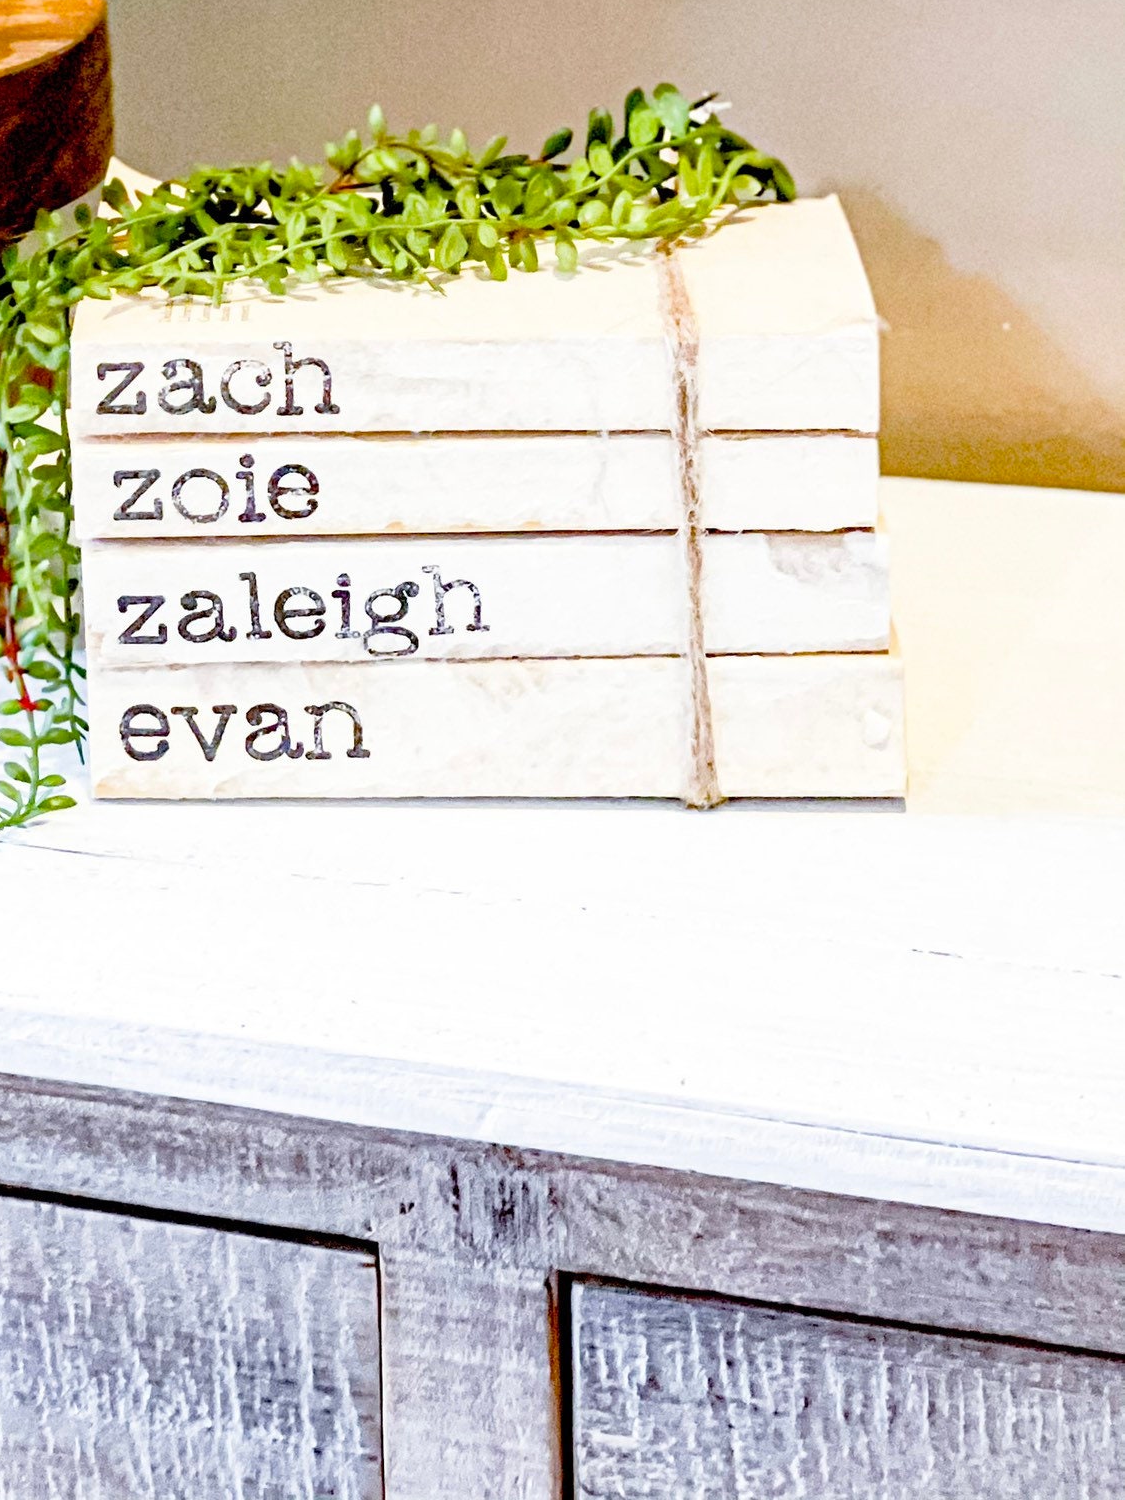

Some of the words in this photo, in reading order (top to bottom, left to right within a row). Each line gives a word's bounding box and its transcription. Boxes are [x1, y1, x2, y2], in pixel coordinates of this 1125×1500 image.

[95, 340, 341, 417] zach
[112, 453, 321, 524] zoie
[116, 564, 491, 657] zaleigh
[118, 700, 372, 763] evan
